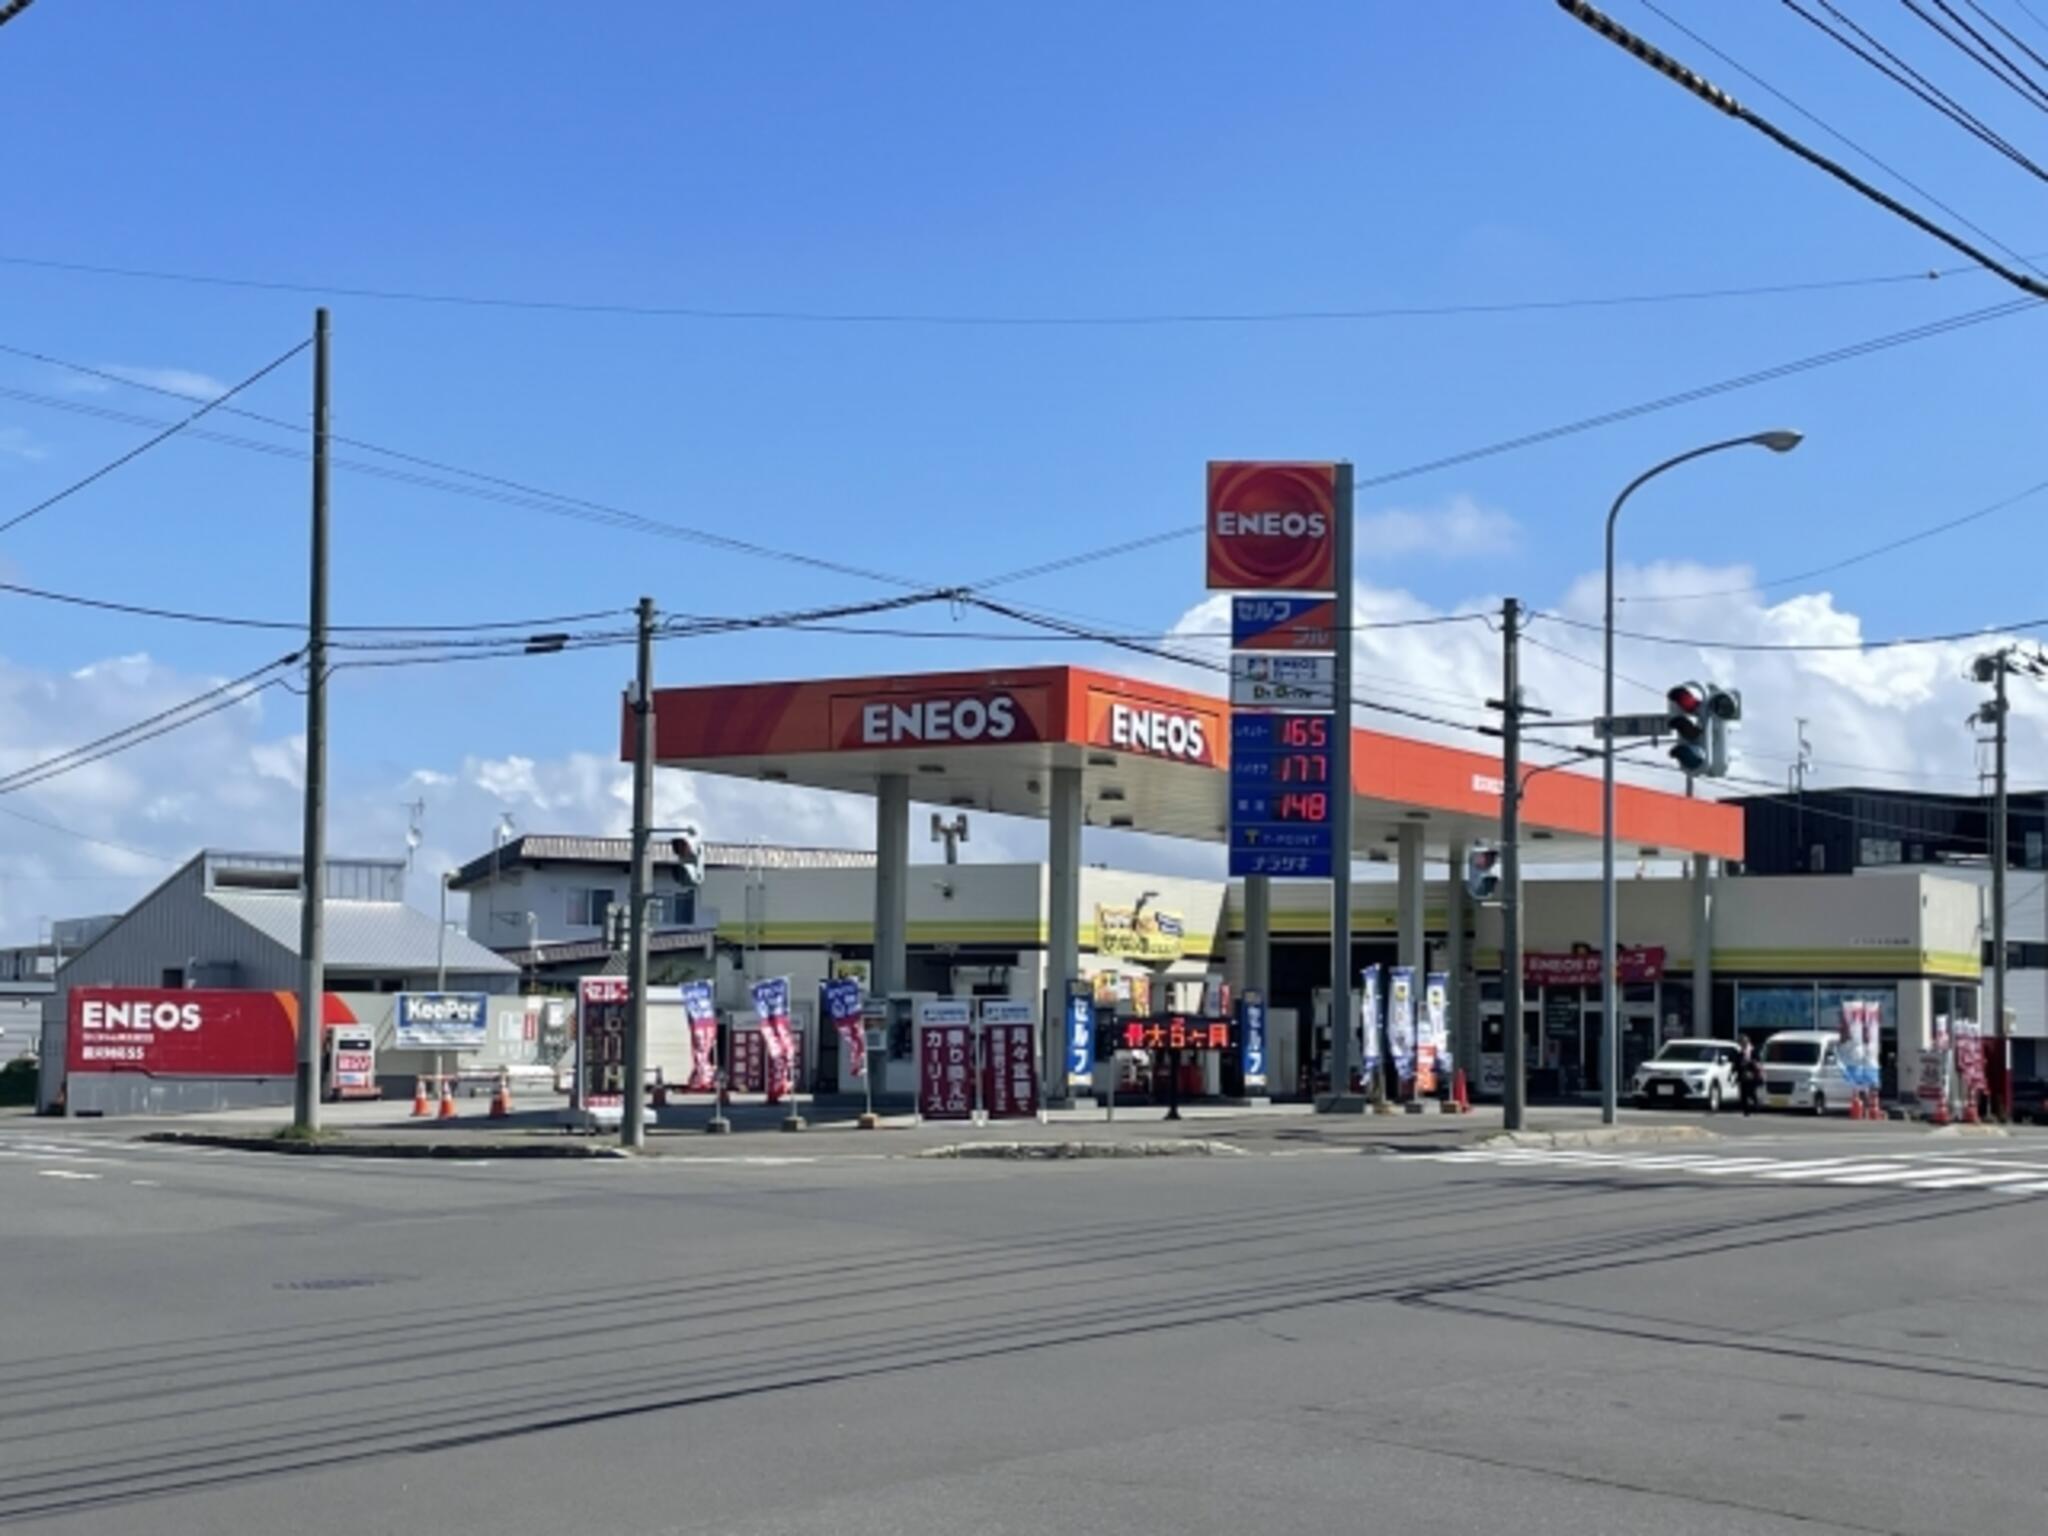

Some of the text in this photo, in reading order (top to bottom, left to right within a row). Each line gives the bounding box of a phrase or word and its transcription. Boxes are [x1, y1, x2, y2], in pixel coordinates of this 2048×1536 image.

[1217, 512, 1326, 538] ENEOS
[1237, 600, 1291, 621] セルフ
[863, 697, 1015, 743] ENEOS
[1112, 703, 1204, 757] ENEOS
[1282, 718, 1326, 747] 165
[1282, 754, 1326, 782] 177
[1282, 793, 1326, 821] 148
[82, 1000, 202, 1031] ENEOS
[407, 997, 480, 1020] KeePer
[1073, 997, 1089, 1073] セルフ
[1246, 1005, 1262, 1074] セルフ
[926, 1030, 945, 1112] カーリース
